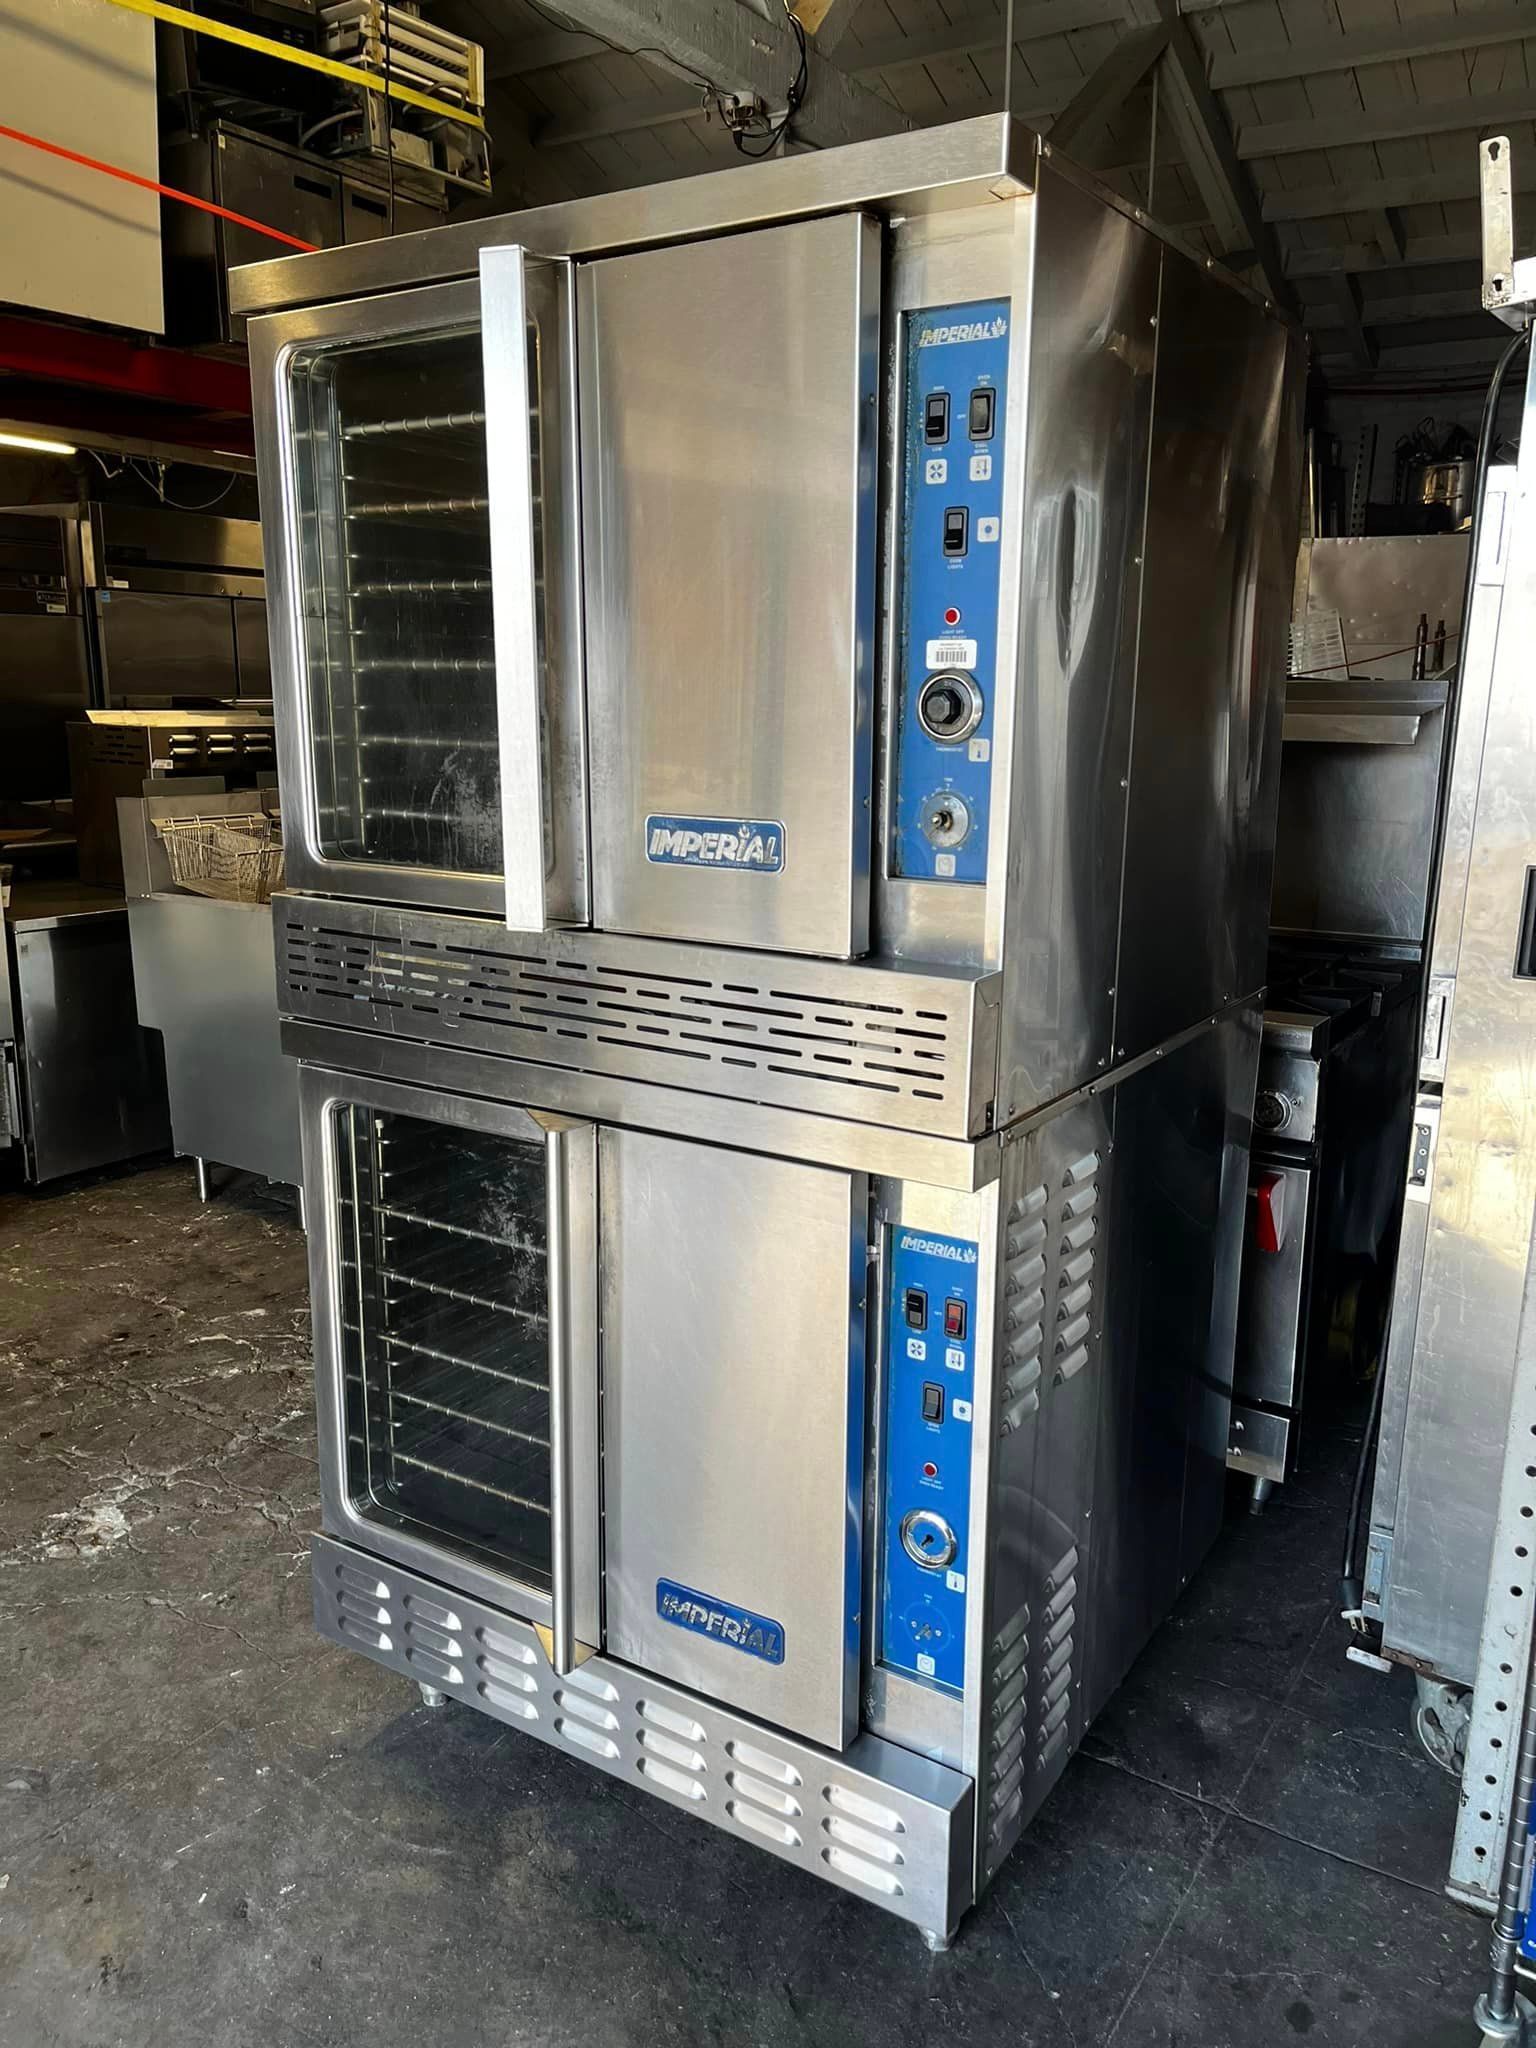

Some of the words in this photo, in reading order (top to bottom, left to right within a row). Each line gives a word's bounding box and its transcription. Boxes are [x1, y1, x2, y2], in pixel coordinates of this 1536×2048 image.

[919, 321, 992, 347] IMPERIAL
[650, 827, 778, 865] IMPERIAL
[901, 1235, 963, 1260] IMPERIAL
[661, 1593, 779, 1658] IMPERIAL
